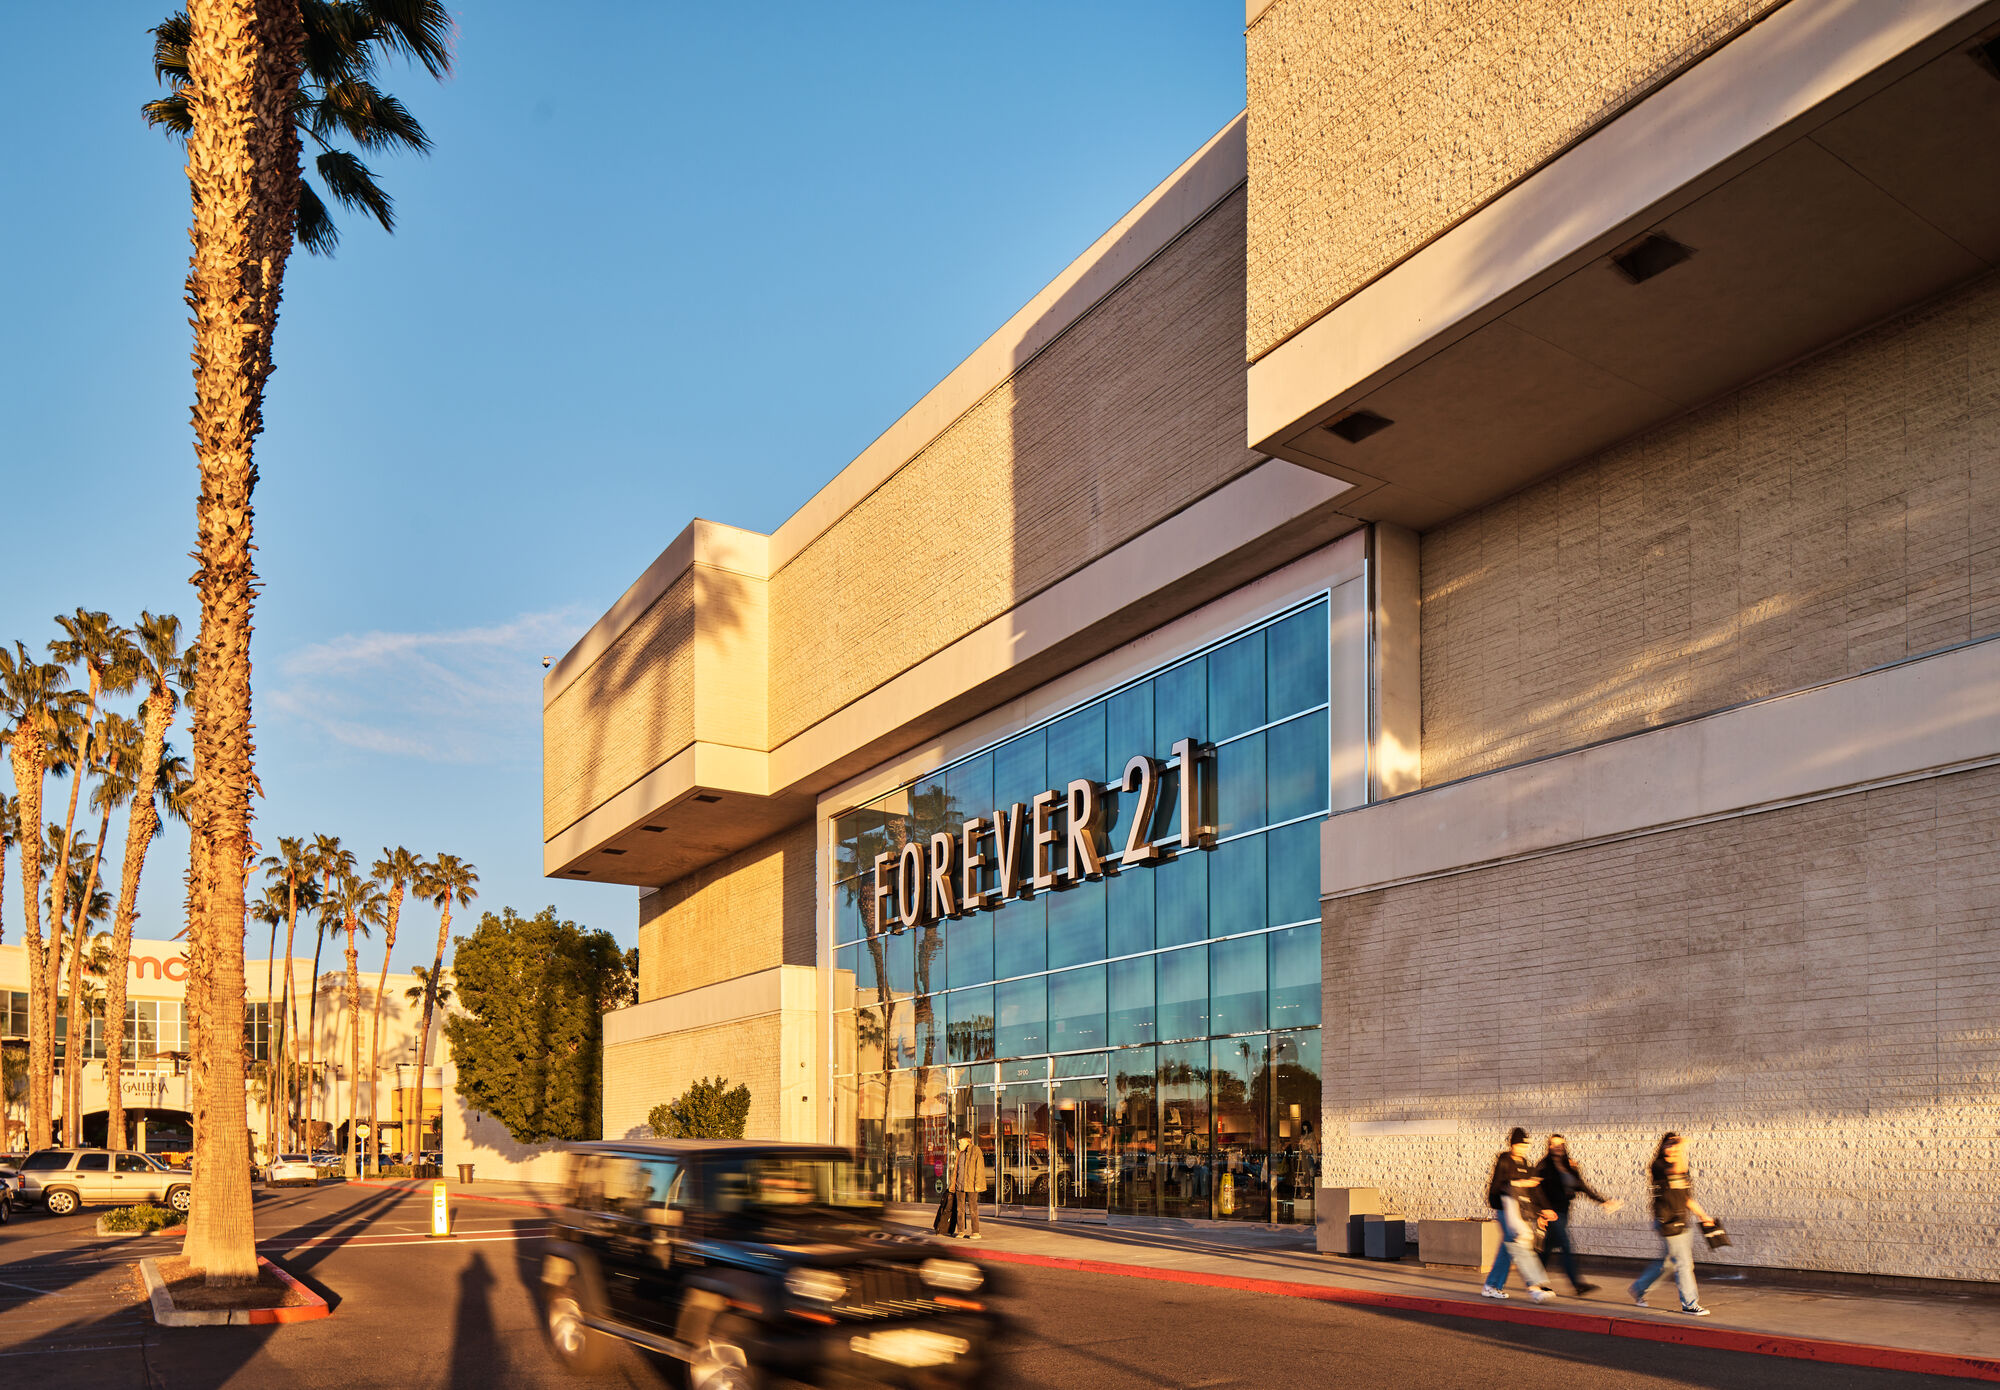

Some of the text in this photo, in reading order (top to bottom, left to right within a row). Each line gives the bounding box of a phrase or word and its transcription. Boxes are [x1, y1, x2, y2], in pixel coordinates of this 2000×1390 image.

[874, 737, 1201, 934] FOREVER 21
[122, 1081, 169, 1094] GALLERIA
